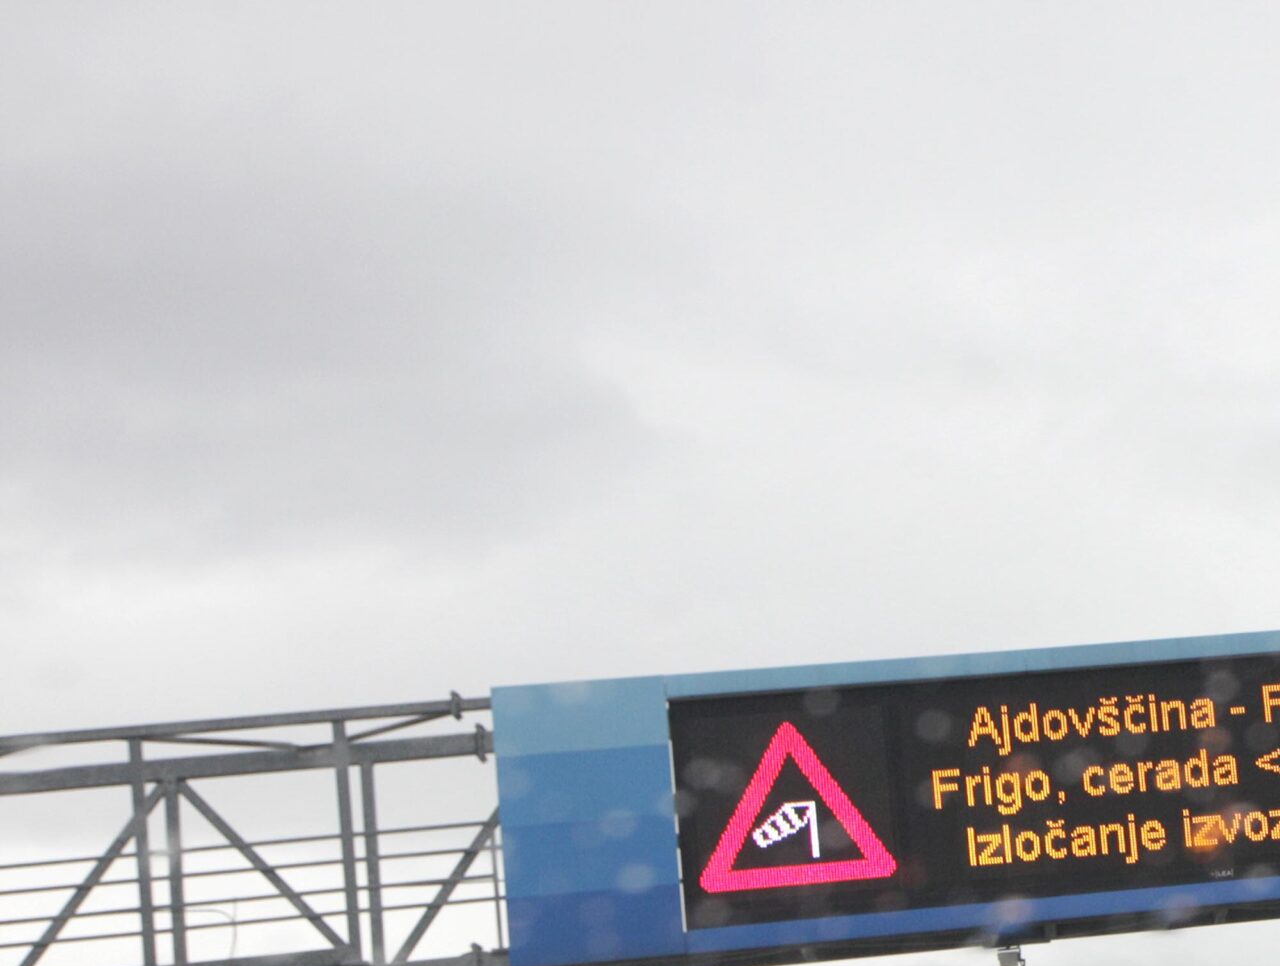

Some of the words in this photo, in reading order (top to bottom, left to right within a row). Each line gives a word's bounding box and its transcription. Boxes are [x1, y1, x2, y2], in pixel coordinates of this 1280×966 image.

[968, 693, 1216, 755] Ajdovščina
[931, 766, 1066, 815] Frigo,
[1082, 748, 1238, 797] cerada
[966, 815, 1166, 865] Izločanje
